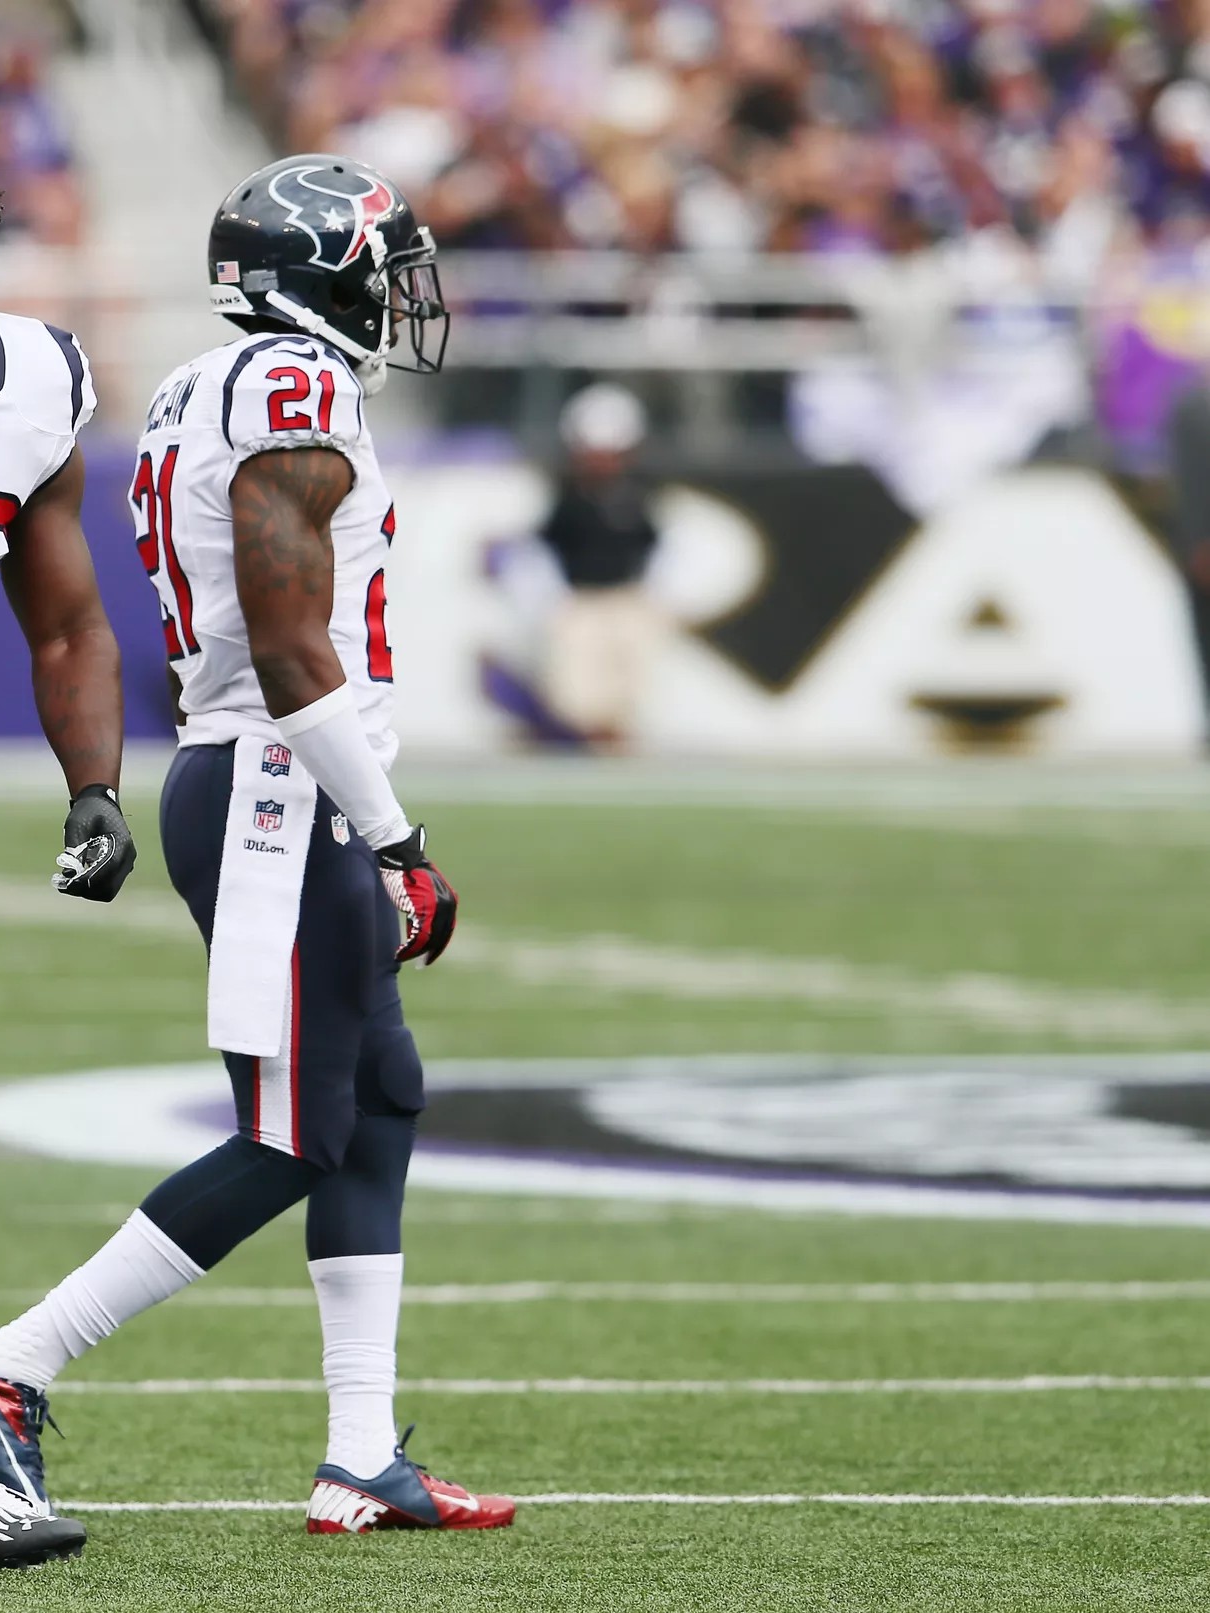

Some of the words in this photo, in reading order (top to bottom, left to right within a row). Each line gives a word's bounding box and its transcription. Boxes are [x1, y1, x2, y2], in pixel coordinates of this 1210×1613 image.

[265, 366, 336, 433] 21
[266, 746, 289, 764] NFL
[257, 813, 279, 829] NFL
[244, 838, 287, 855] Wilson
[306, 1480, 389, 1533] NIKE
